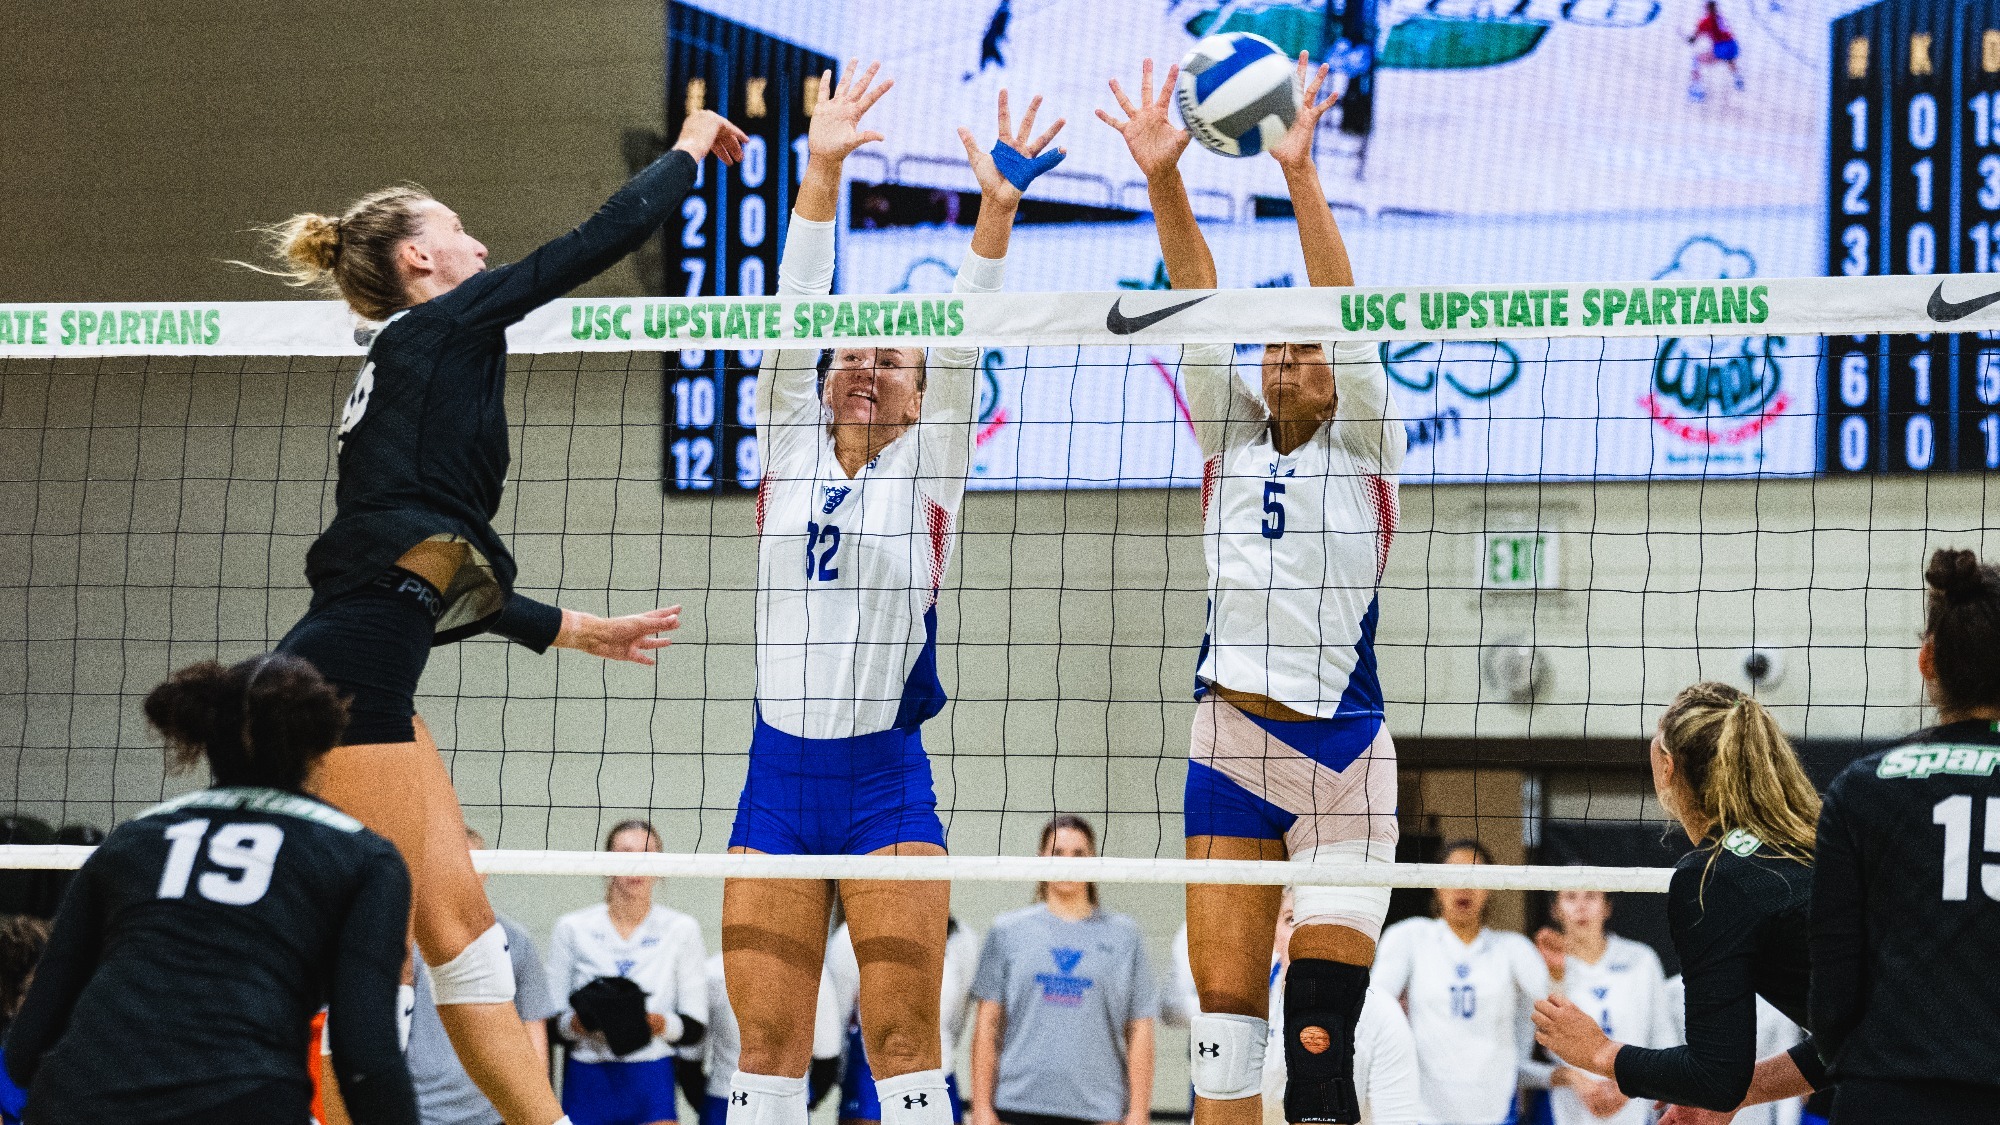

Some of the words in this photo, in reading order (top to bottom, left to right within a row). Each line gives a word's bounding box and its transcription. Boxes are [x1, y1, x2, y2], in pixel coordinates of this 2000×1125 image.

[1909, 32, 1932, 76] K
[746, 77, 767, 118] K
[1846, 96, 1868, 151] 1
[1908, 93, 1938, 150] 0
[741, 134, 767, 188] 0
[1842, 159, 1871, 215] 2
[1911, 157, 1933, 213] 1
[1977, 154, 2000, 211] 3
[681, 195, 707, 248] 2
[739, 194, 766, 248] 0
[1841, 224, 1870, 276] 3
[1907, 222, 1936, 274] 0
[60, 309, 221, 346] SPARTANS
[571, 304, 632, 340] USC
[643, 302, 782, 340] UPSTATE
[793, 299, 965, 339] SPARTANS
[1340, 293, 1406, 332] USC
[1420, 288, 1569, 331] UPSTATE
[1582, 284, 1770, 327] SPARTANS
[672, 376, 716, 430] 10
[1840, 351, 1869, 407] 6
[1909, 350, 1931, 406] 1
[1976, 347, 2000, 405] 5
[671, 435, 715, 490] 12
[1840, 413, 1869, 471] 0
[1905, 412, 1934, 470] 0
[1262, 480, 1286, 540] 5
[1488, 536, 1546, 582] EXIT
[156, 818, 285, 906] 19
[1449, 984, 1477, 1019] 10
